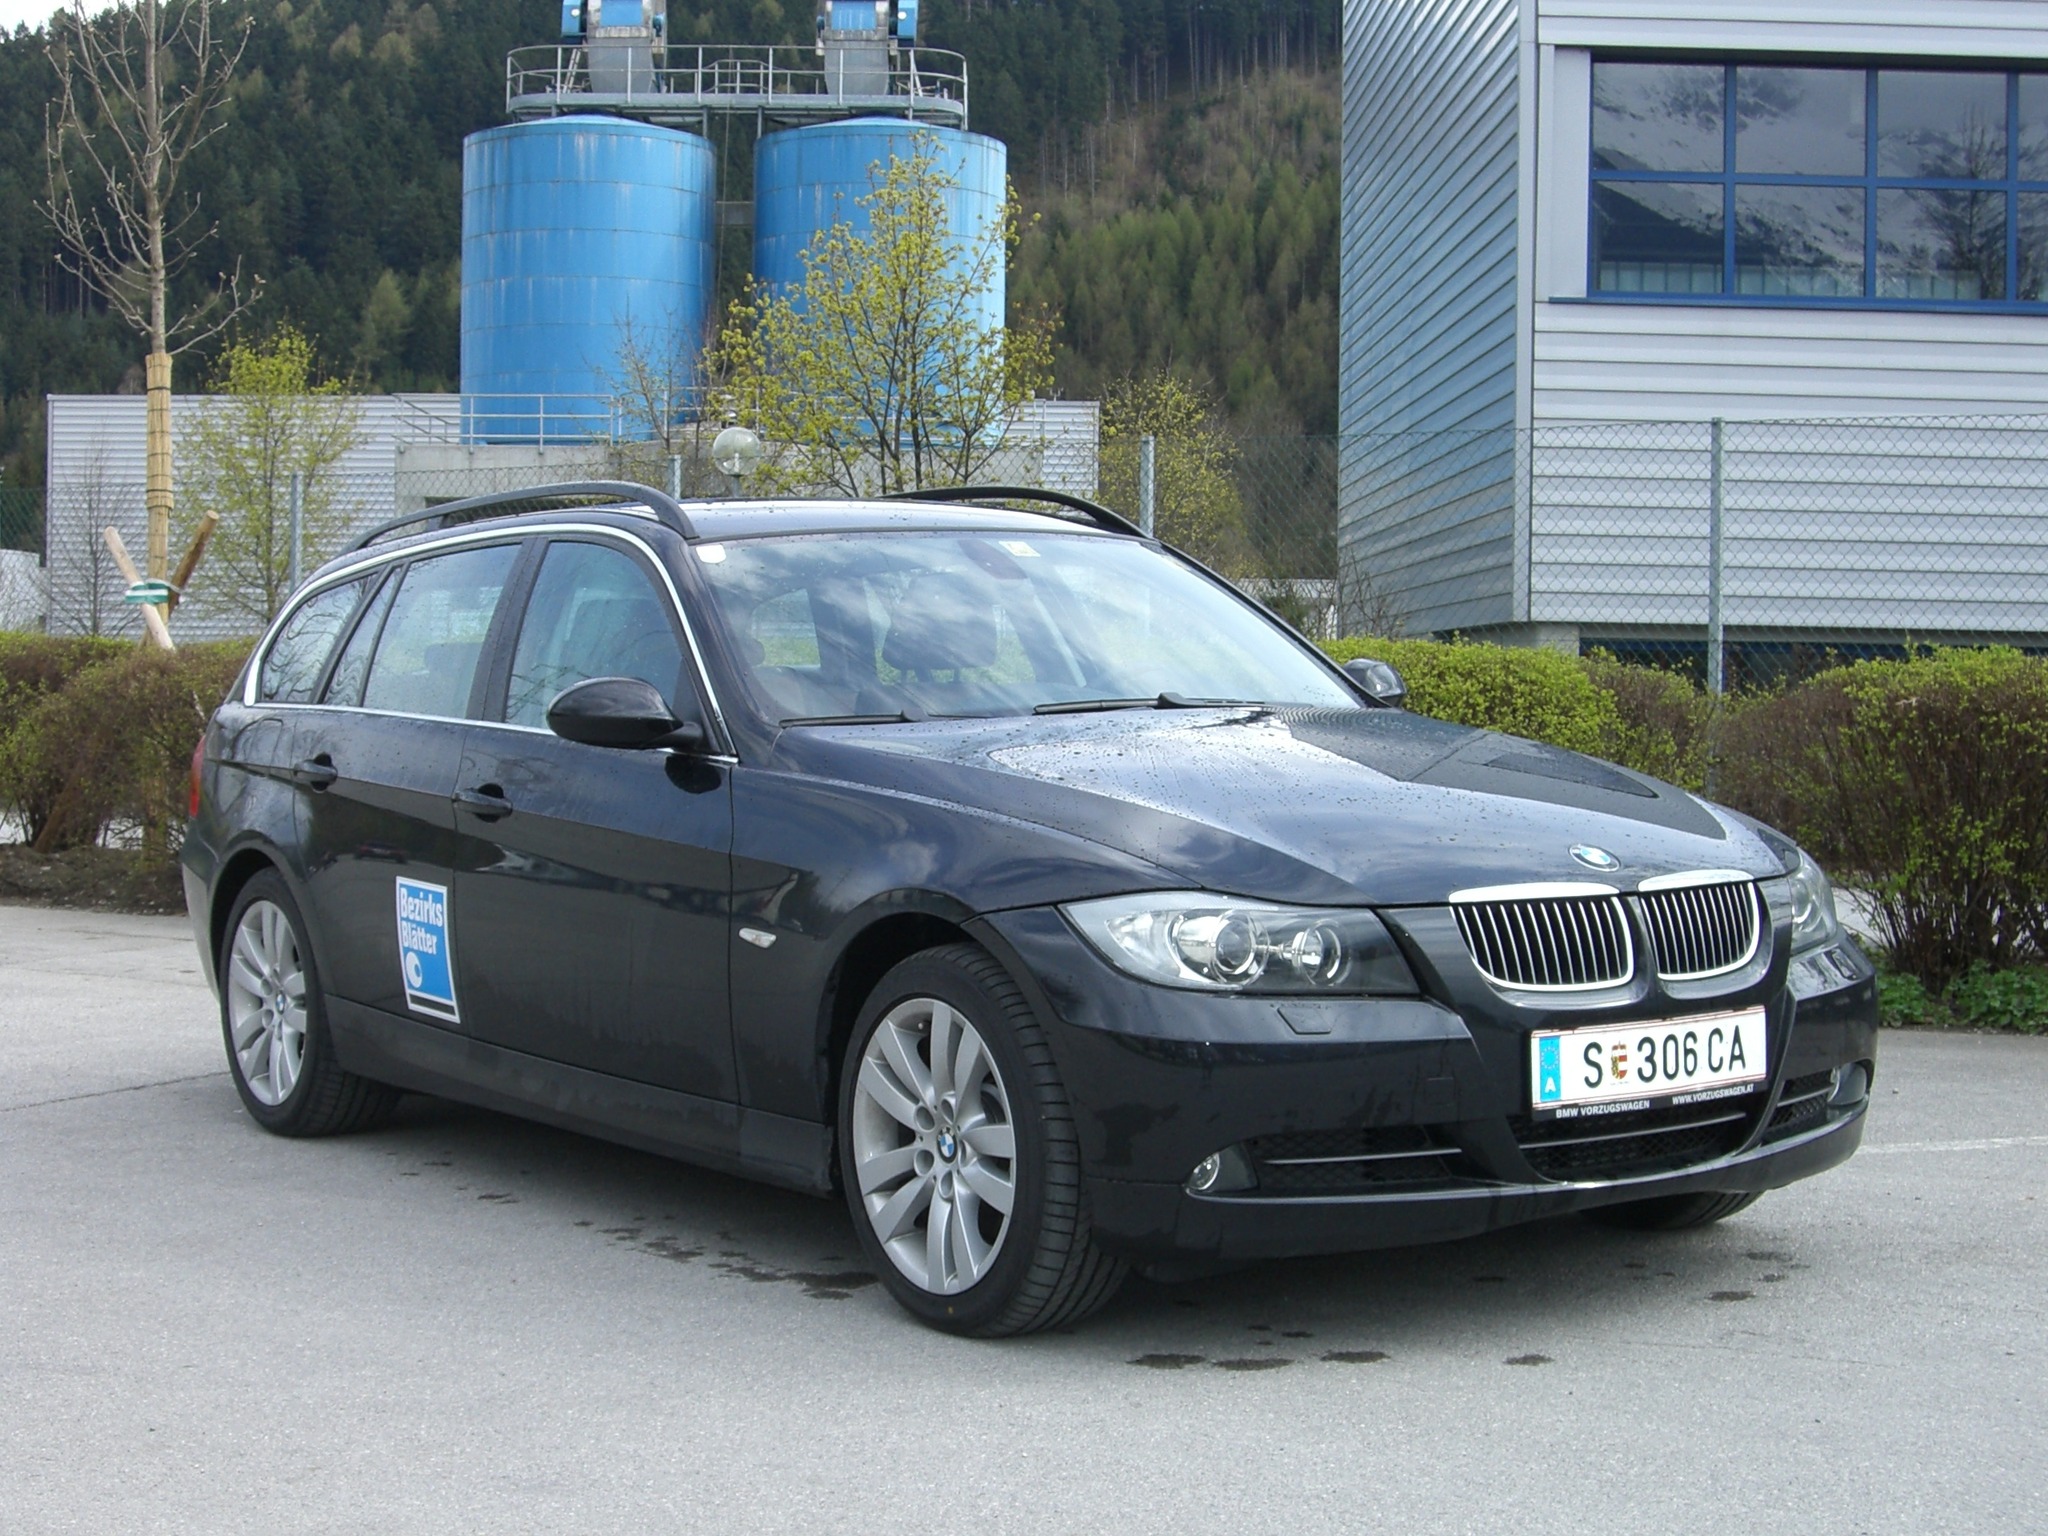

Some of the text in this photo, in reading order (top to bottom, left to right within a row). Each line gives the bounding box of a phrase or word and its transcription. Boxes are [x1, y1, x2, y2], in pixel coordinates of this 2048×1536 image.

[400, 887, 443, 927] Bezirks
[401, 920, 437, 955] Blätter
[1583, 1024, 1746, 1089] S 306 CA
[1544, 1077, 1557, 1093] A
[1672, 1083, 1755, 1105] WWW.VORZUGSWAGEN.AT
[1556, 1100, 1650, 1119] BMW VORZUGSWAGEN
